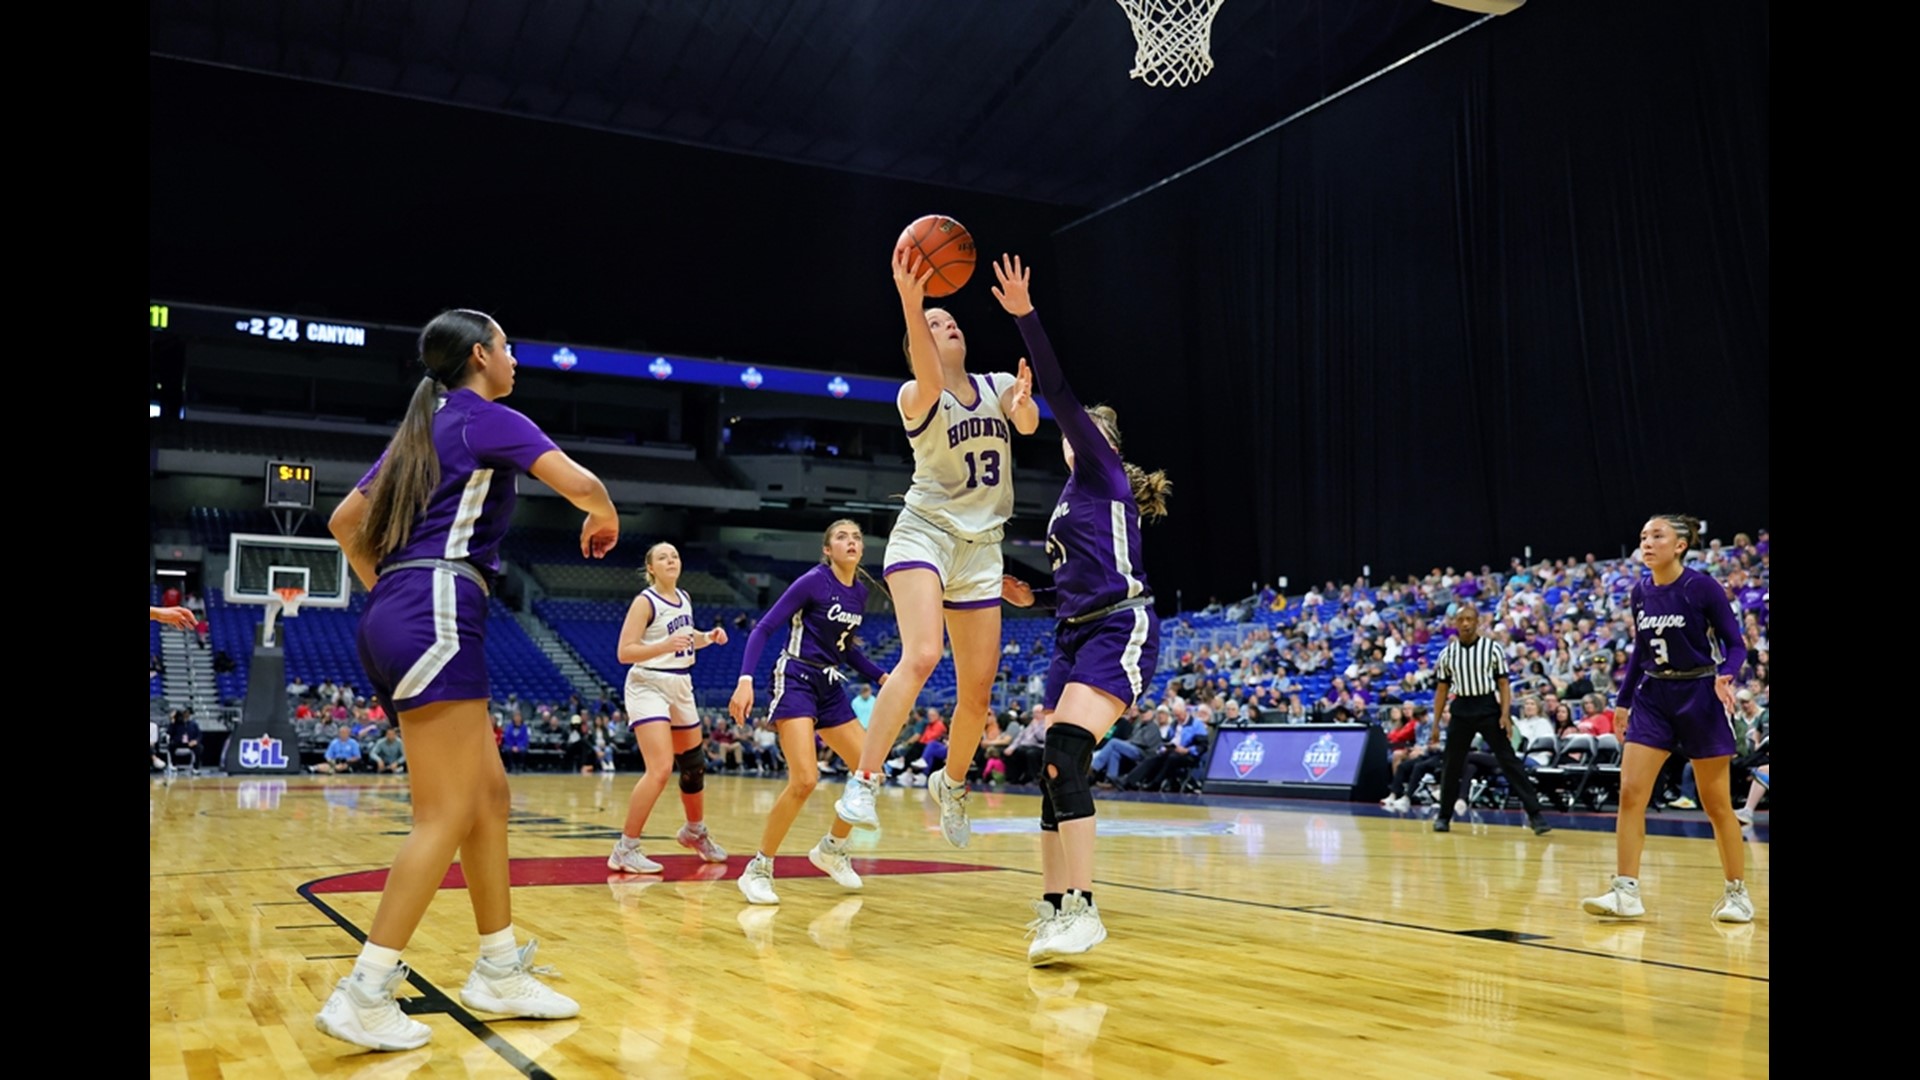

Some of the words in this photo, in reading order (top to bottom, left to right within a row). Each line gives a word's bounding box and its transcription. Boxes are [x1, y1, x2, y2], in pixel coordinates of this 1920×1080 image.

[250, 318, 265, 336] 2
[267, 317, 299, 341] 24
[306, 323, 365, 346] CANYON
[279, 465, 310, 481] 5:11
[964, 450, 1000, 489] 13
[1636, 610, 1686, 636] Canyon
[1650, 638, 1669, 666] 3
[1231, 750, 1264, 763] STATE
[1304, 752, 1340, 764] STATE
